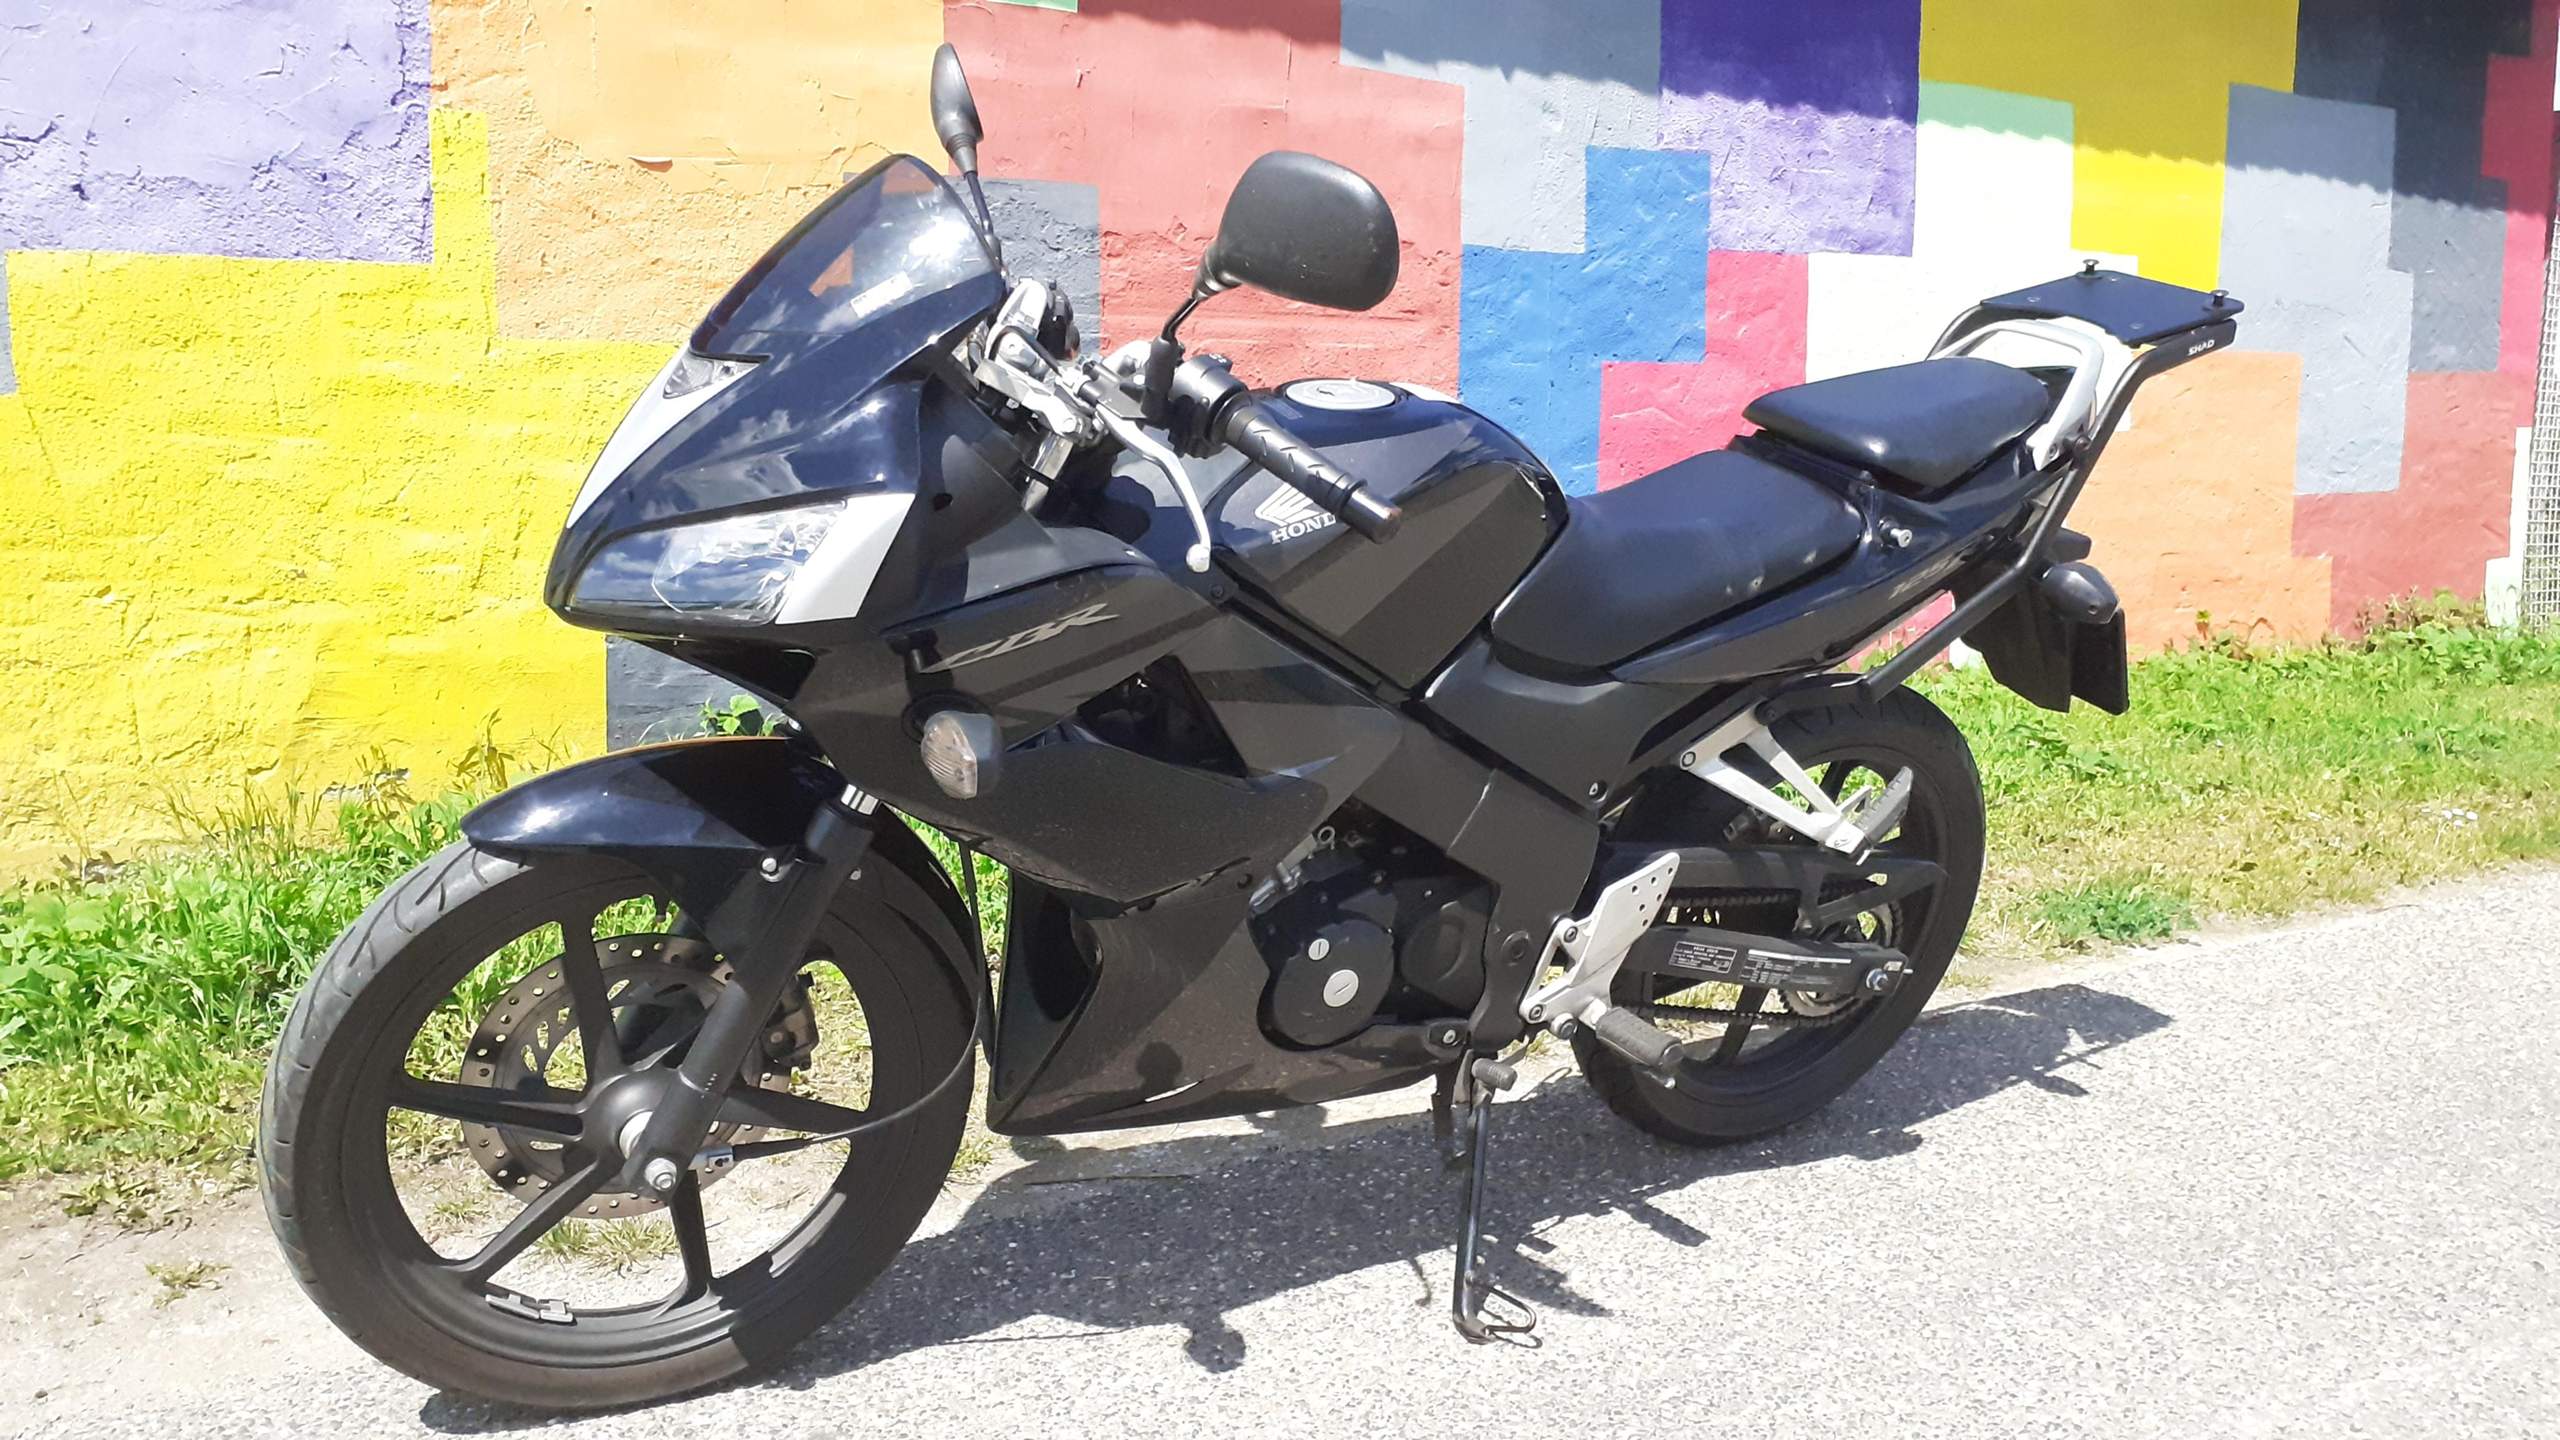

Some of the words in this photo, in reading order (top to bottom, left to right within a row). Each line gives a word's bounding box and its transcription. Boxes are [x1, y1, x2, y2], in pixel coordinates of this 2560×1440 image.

[2188, 339, 2216, 356] SHAD
[1270, 512, 1337, 545] HOND
[920, 603, 1121, 674] CBR
